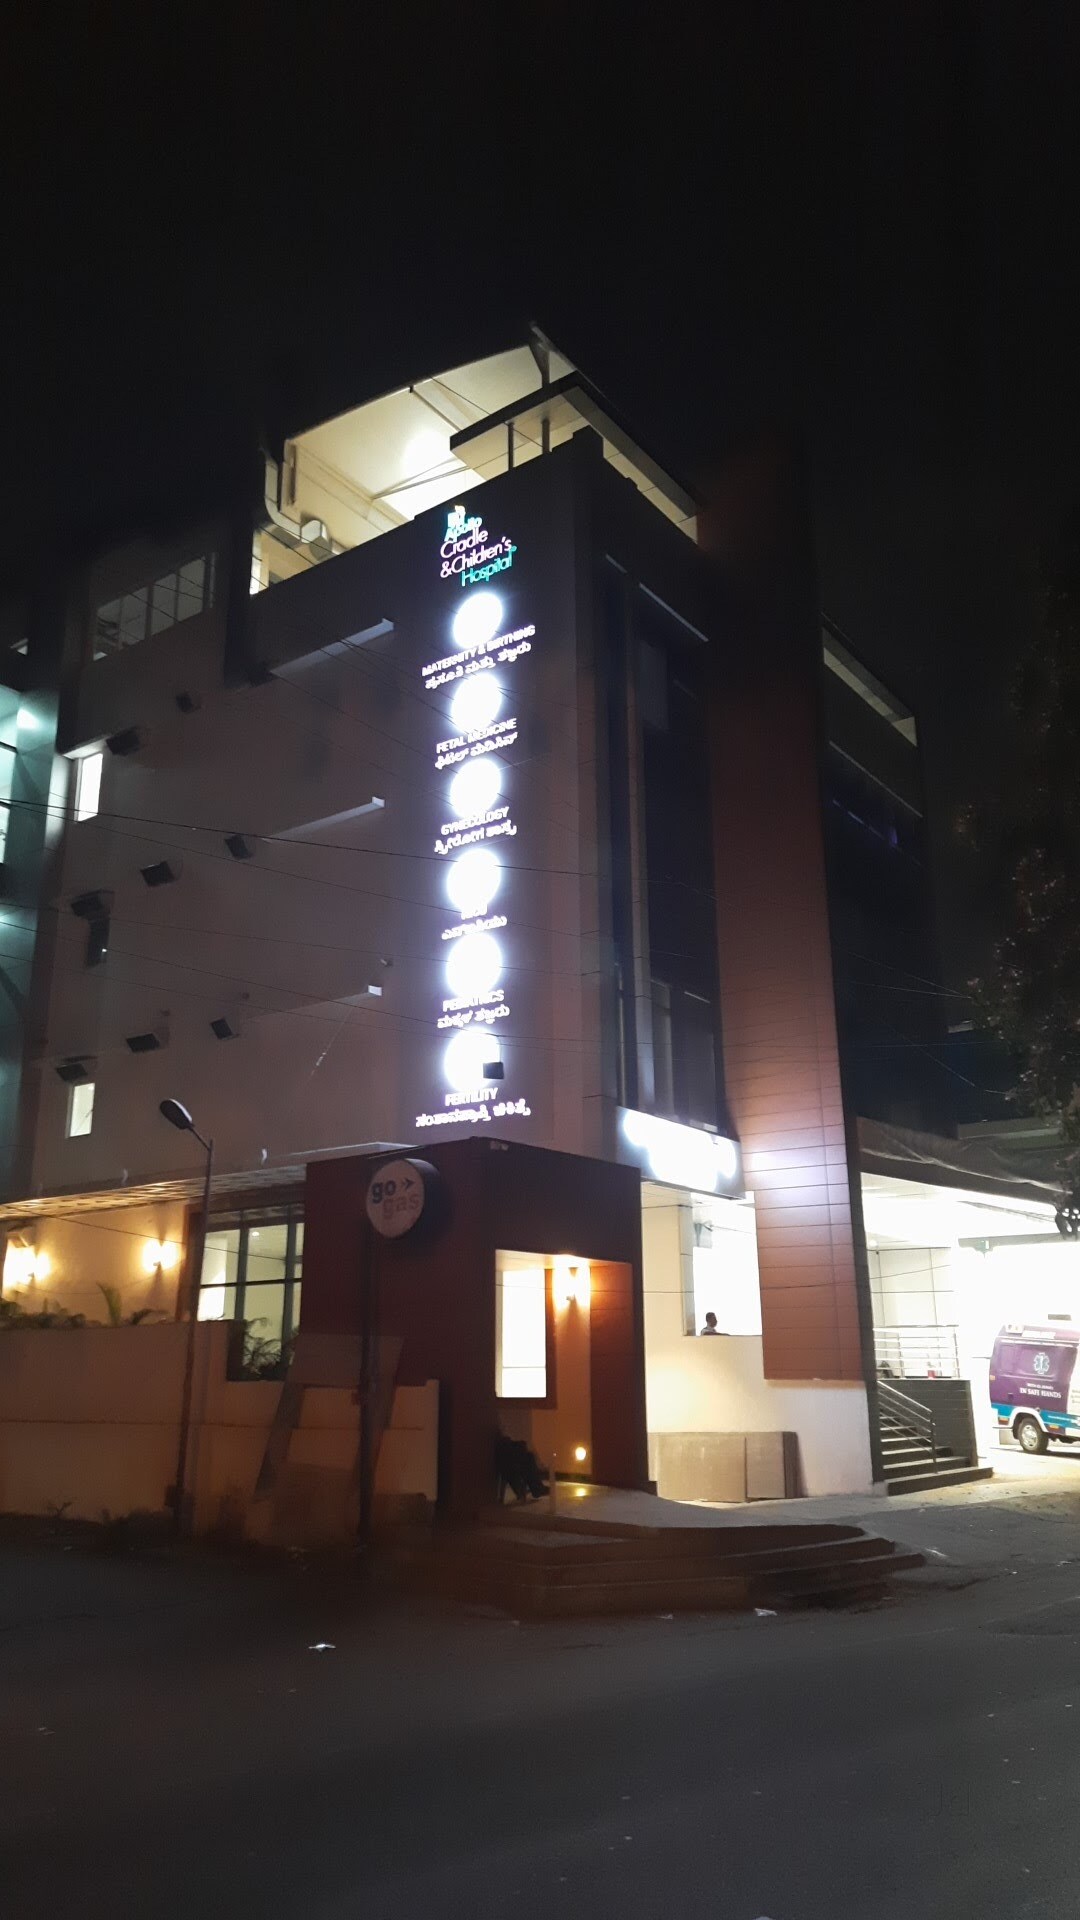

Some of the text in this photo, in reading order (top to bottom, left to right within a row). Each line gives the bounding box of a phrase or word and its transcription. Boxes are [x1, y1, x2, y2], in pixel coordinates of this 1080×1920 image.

[440, 528, 488, 558] Cradle
[461, 549, 513, 587] Hospital
[421, 647, 478, 677] MATERNITY
[436, 718, 517, 754] FETAL MEDICINE
[441, 806, 509, 835] GYNECOLOGY
[445, 1087, 498, 1106] FERTILITY
[371, 1180, 397, 1204] go
[383, 1193, 419, 1220] gas
